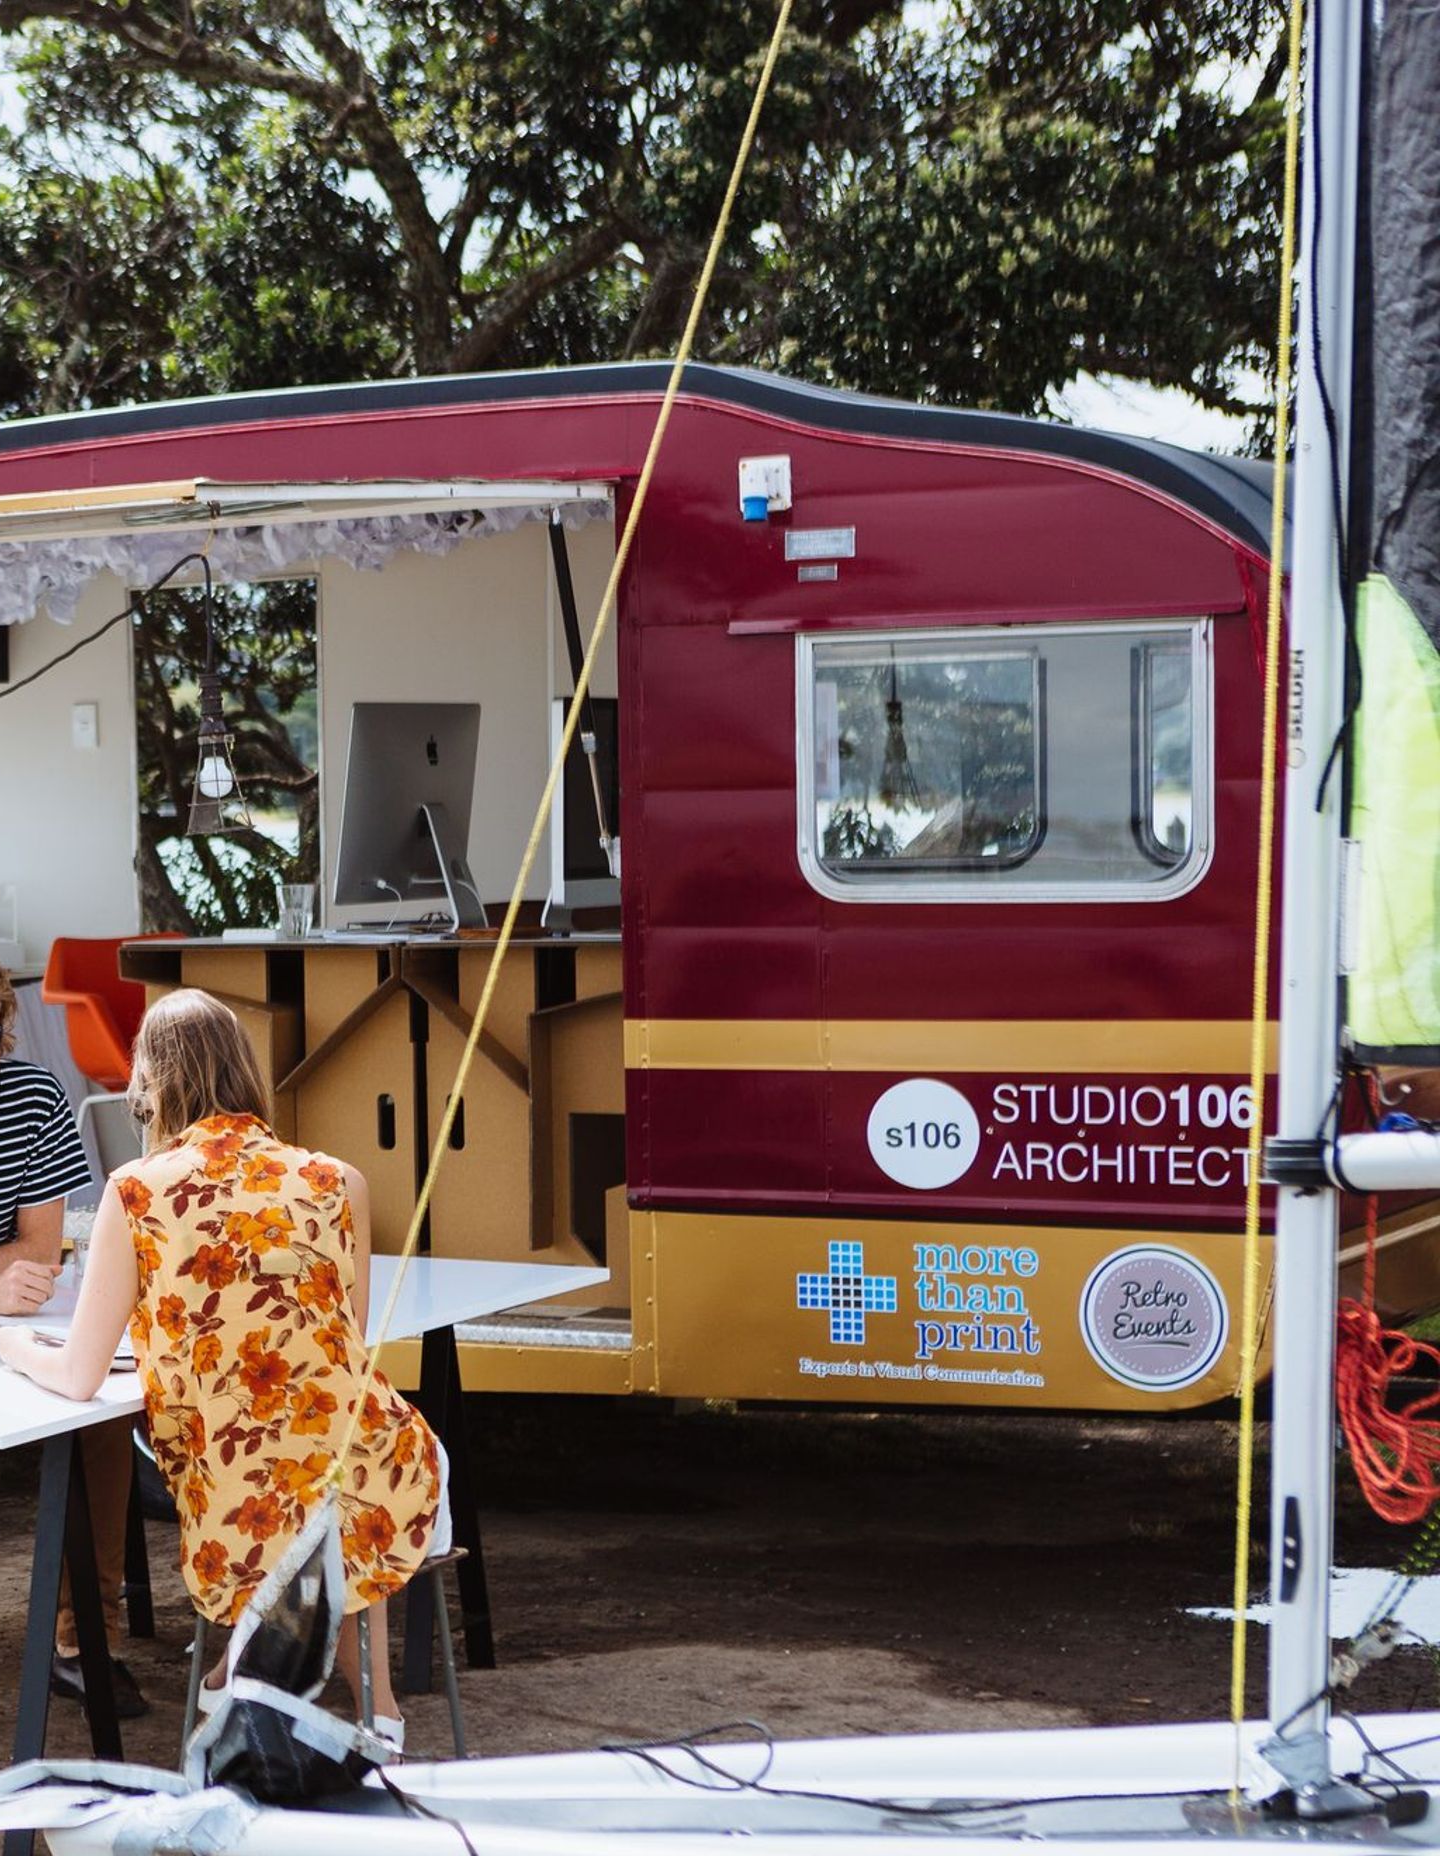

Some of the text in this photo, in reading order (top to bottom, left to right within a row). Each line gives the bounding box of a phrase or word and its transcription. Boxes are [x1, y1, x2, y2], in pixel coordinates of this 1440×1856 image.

[1289, 649, 1304, 739] SELDEN
[992, 1083, 1258, 1129] STUDIO106
[885, 1121, 961, 1150] s106
[914, 1243, 1039, 1277] more
[914, 1271, 1029, 1315] than
[1120, 1279, 1188, 1310] Retro
[914, 1313, 1041, 1359] print
[1112, 1308, 1197, 1341] Events
[799, 1357, 1044, 1387] Experts in Visual Communication
